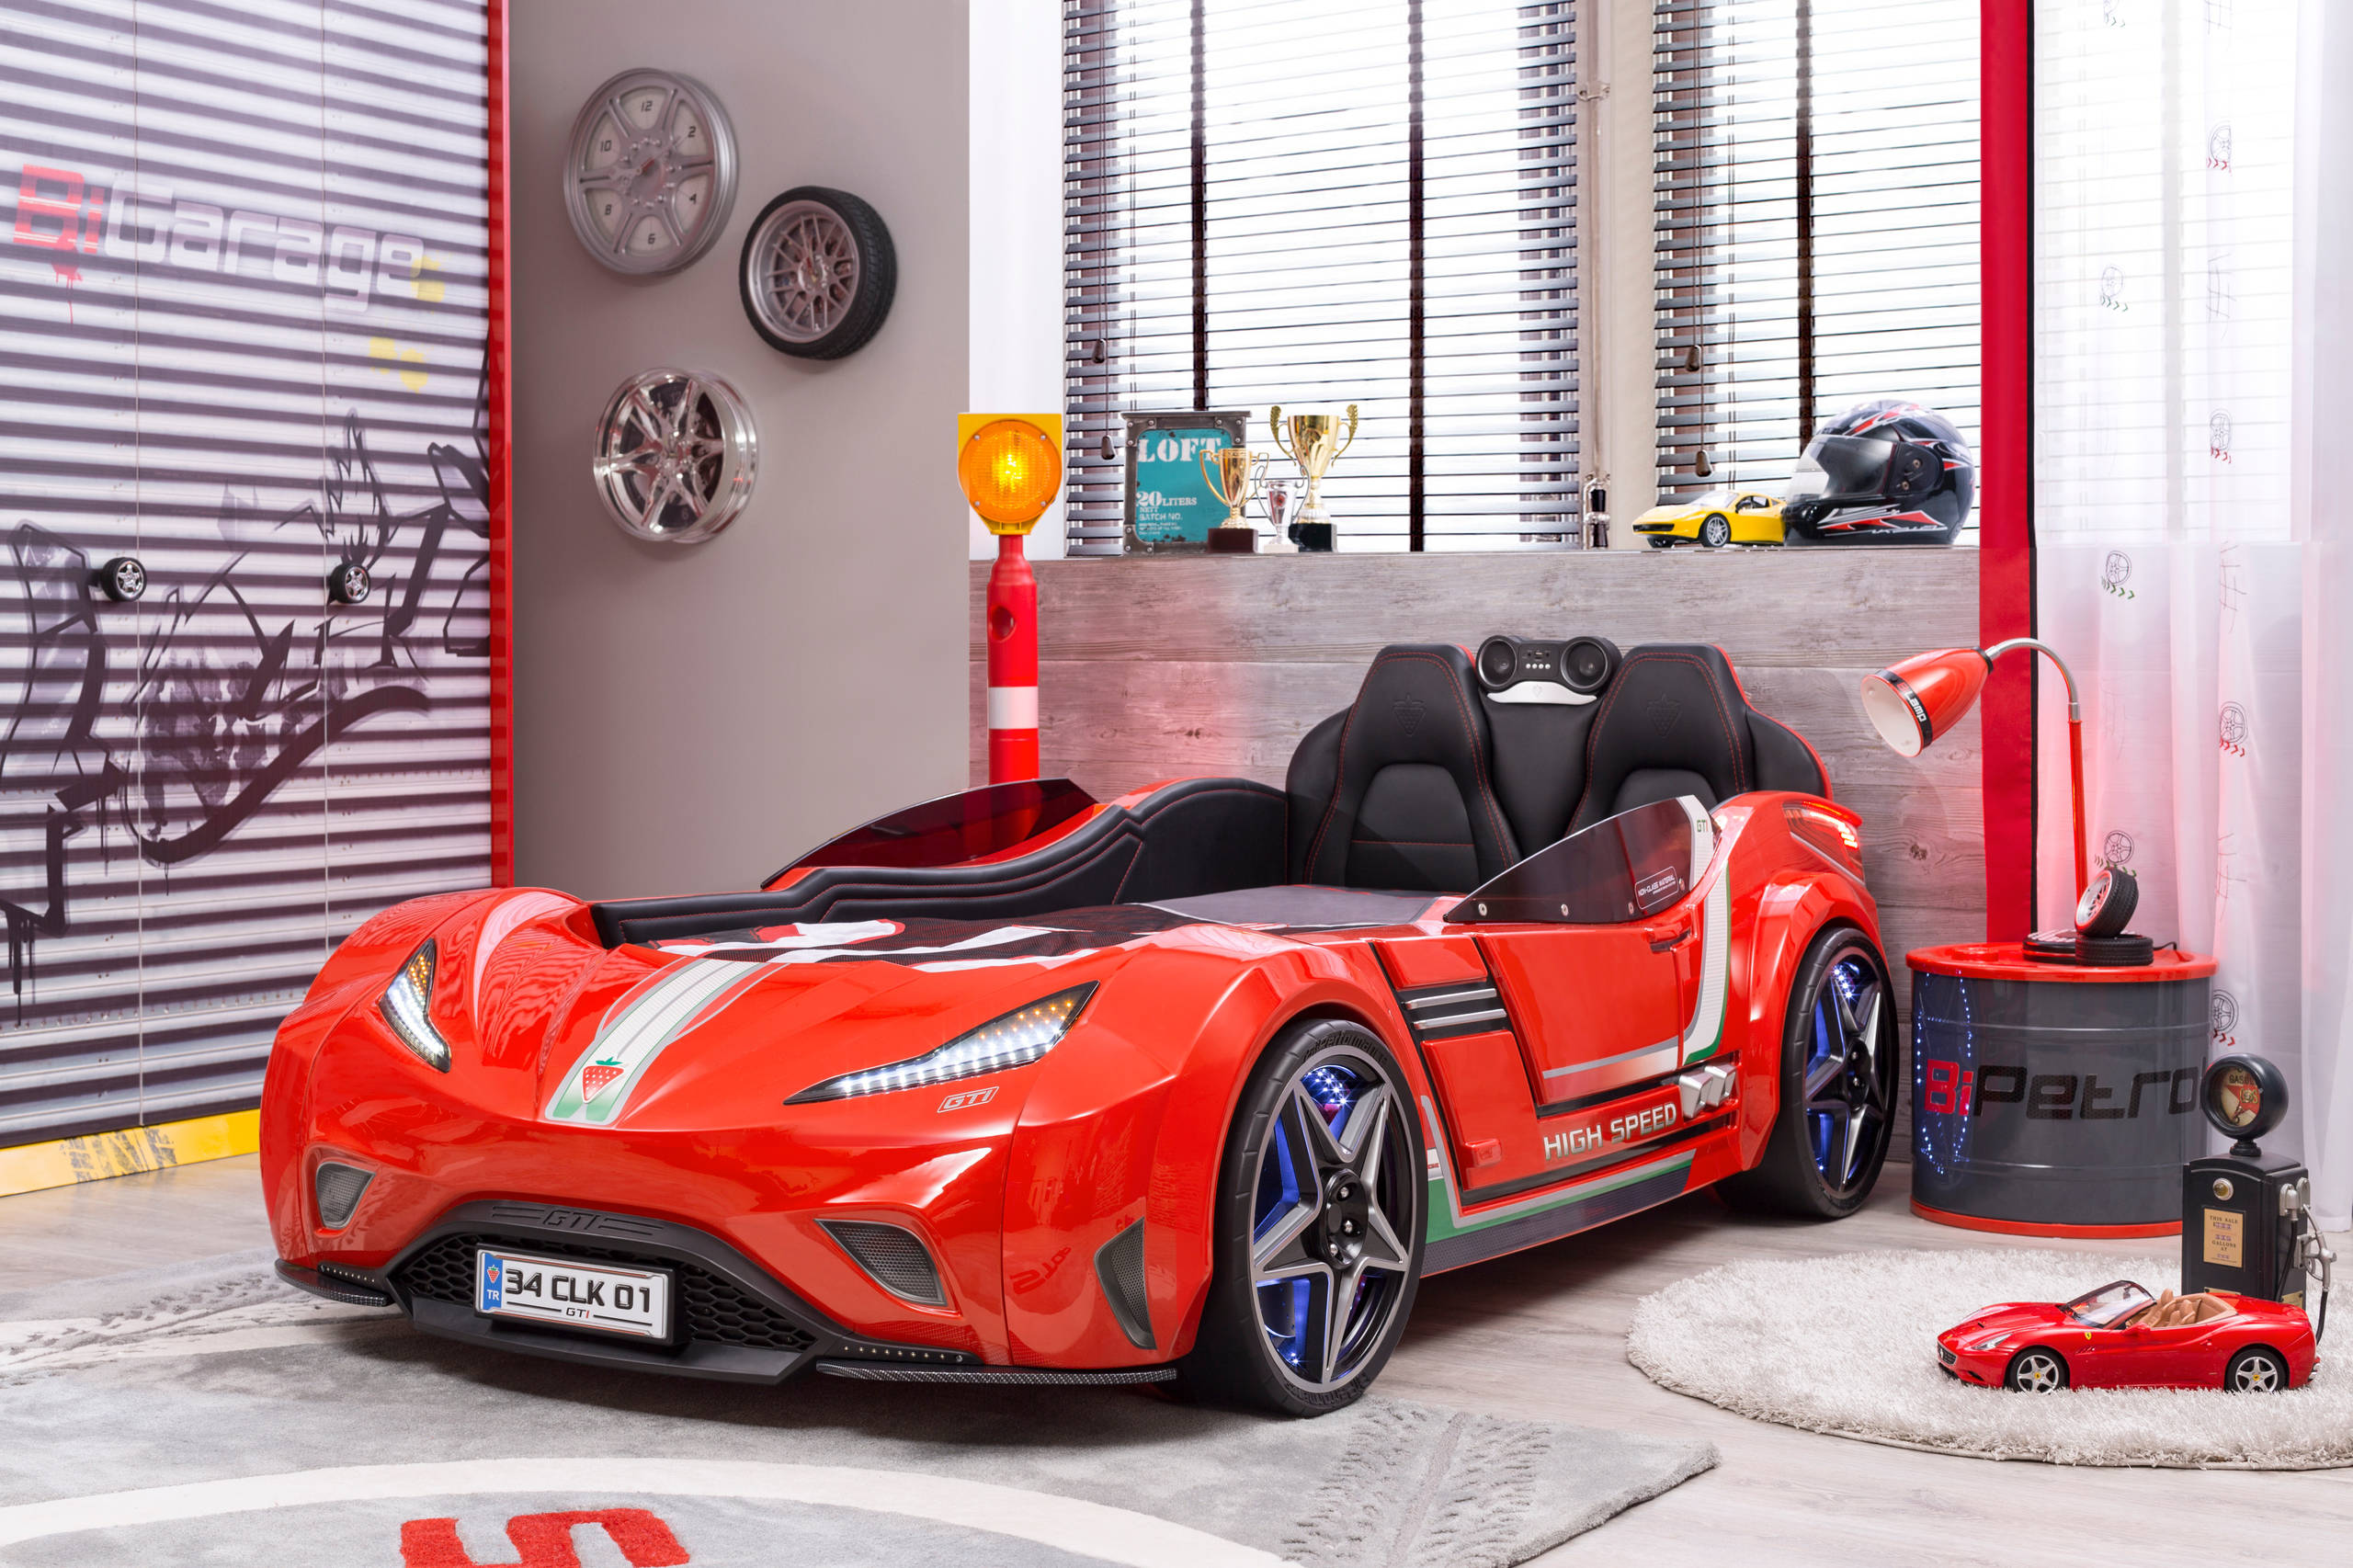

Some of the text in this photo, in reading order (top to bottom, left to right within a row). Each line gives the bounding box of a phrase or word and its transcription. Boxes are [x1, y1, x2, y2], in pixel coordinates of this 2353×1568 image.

[641, 100, 654, 111] 12
[688, 126, 697, 138] 2
[600, 140, 611, 152] 10
[688, 193, 697, 205] 4
[605, 204, 612, 216] 8
[647, 233, 655, 245] 6
[1138, 437, 1222, 462] LOFT
[1136, 491, 1198, 506] 20 LITERS
[1696, 819, 1709, 833] GTI
[943, 1089, 994, 1109] GTI
[1543, 1103, 1677, 1161] HIGH SPEED
[543, 1210, 600, 1231] GTI
[486, 1289, 500, 1301] TR
[505, 1267, 650, 1313] 34 CLK 01
[565, 1307, 590, 1319] GTI
